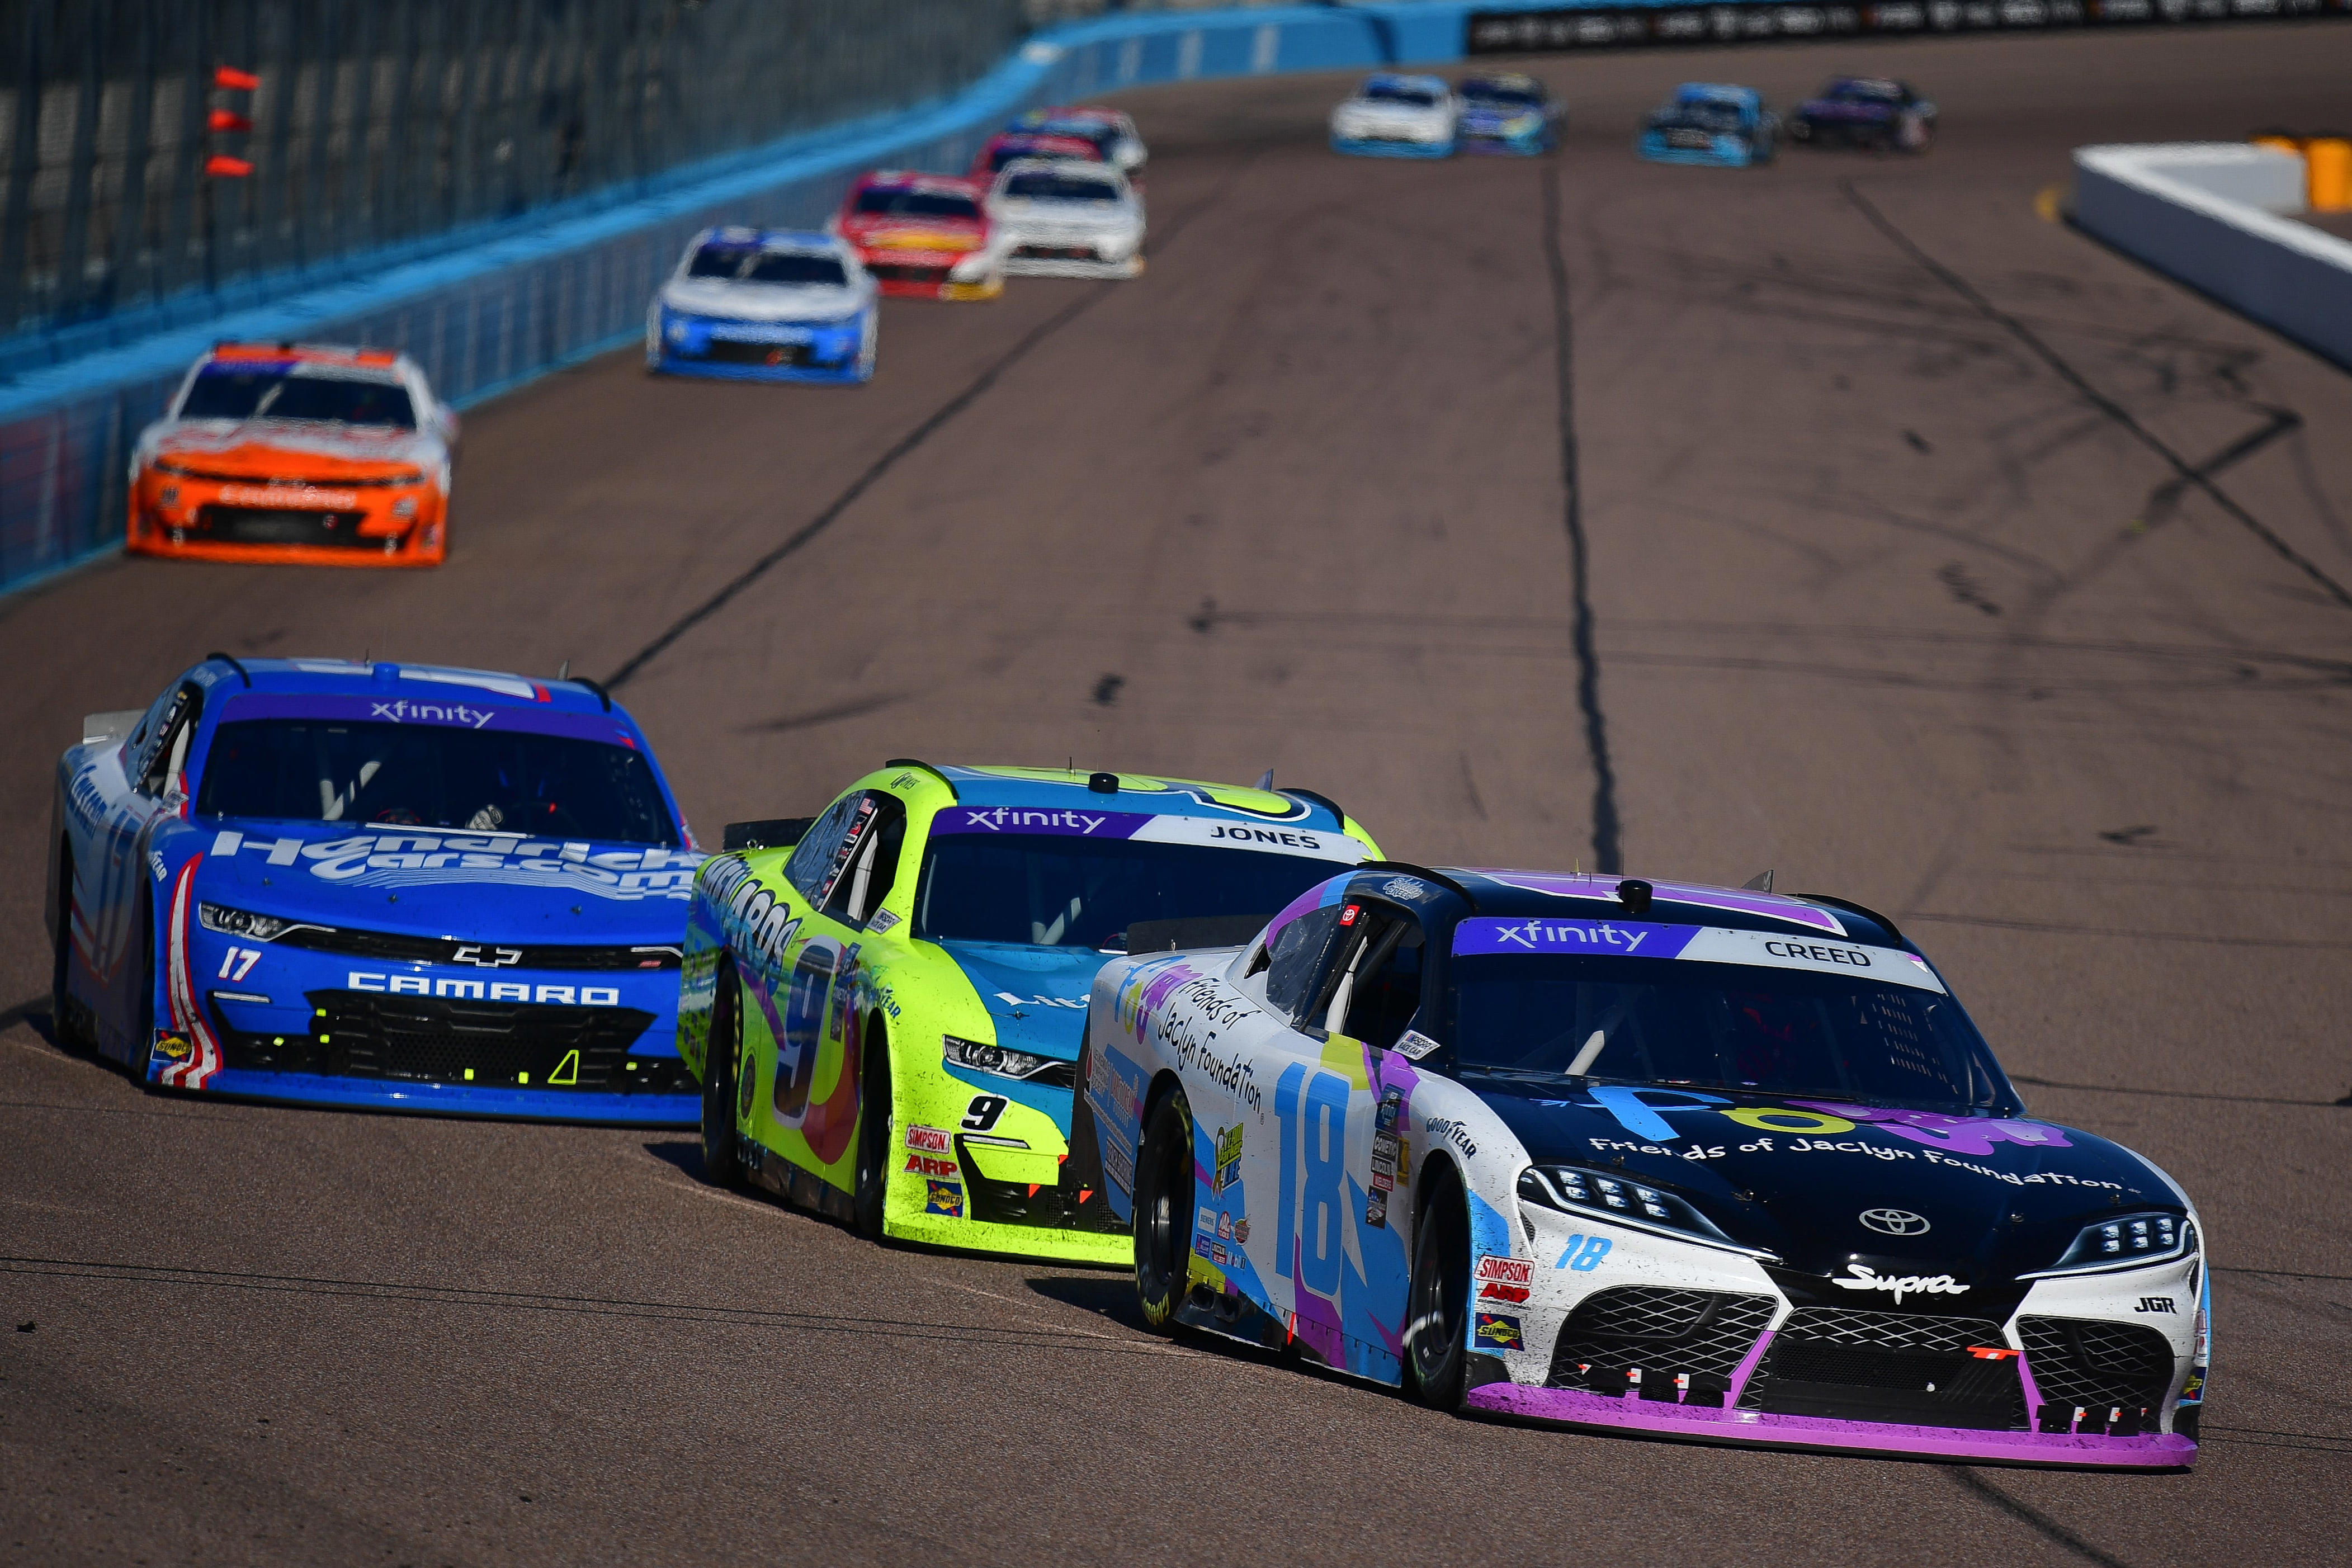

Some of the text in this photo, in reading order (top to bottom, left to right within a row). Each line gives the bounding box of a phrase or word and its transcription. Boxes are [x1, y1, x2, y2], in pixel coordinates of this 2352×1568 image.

[370, 700, 494, 728] xfinity
[967, 807, 1106, 834] xfinity
[1211, 826, 1320, 849] JONES
[1495, 921, 1648, 951] xfinity
[218, 946, 262, 982] 17
[1765, 941, 1871, 967] CREED
[348, 972, 620, 1005] CAMARO
[1178, 978, 1262, 1031] Friends of
[772, 935, 842, 1130] 9
[1158, 1002, 1196, 1071] Jaclyn
[1197, 1031, 1261, 1114] Foundation
[960, 1094, 1010, 1132] 9
[908, 1128, 946, 1150] SIMPSON
[1427, 1117, 1476, 1160] GOODYEAR
[905, 1155, 957, 1177] ARP
[1275, 1061, 1350, 1297] 18
[1372, 1159, 1391, 1176] LINCOLN
[1589, 1138, 2123, 1190] Friends of Jaclyn Foundation
[1555, 1234, 1612, 1271] 18
[1480, 1259, 1531, 1282] SIMPSON
[1833, 1264, 1970, 1305] Supra
[1480, 1283, 1530, 1303] ARP
[2133, 1297, 2178, 1314] JGR
[1480, 1326, 1520, 1338] SUNOCO
